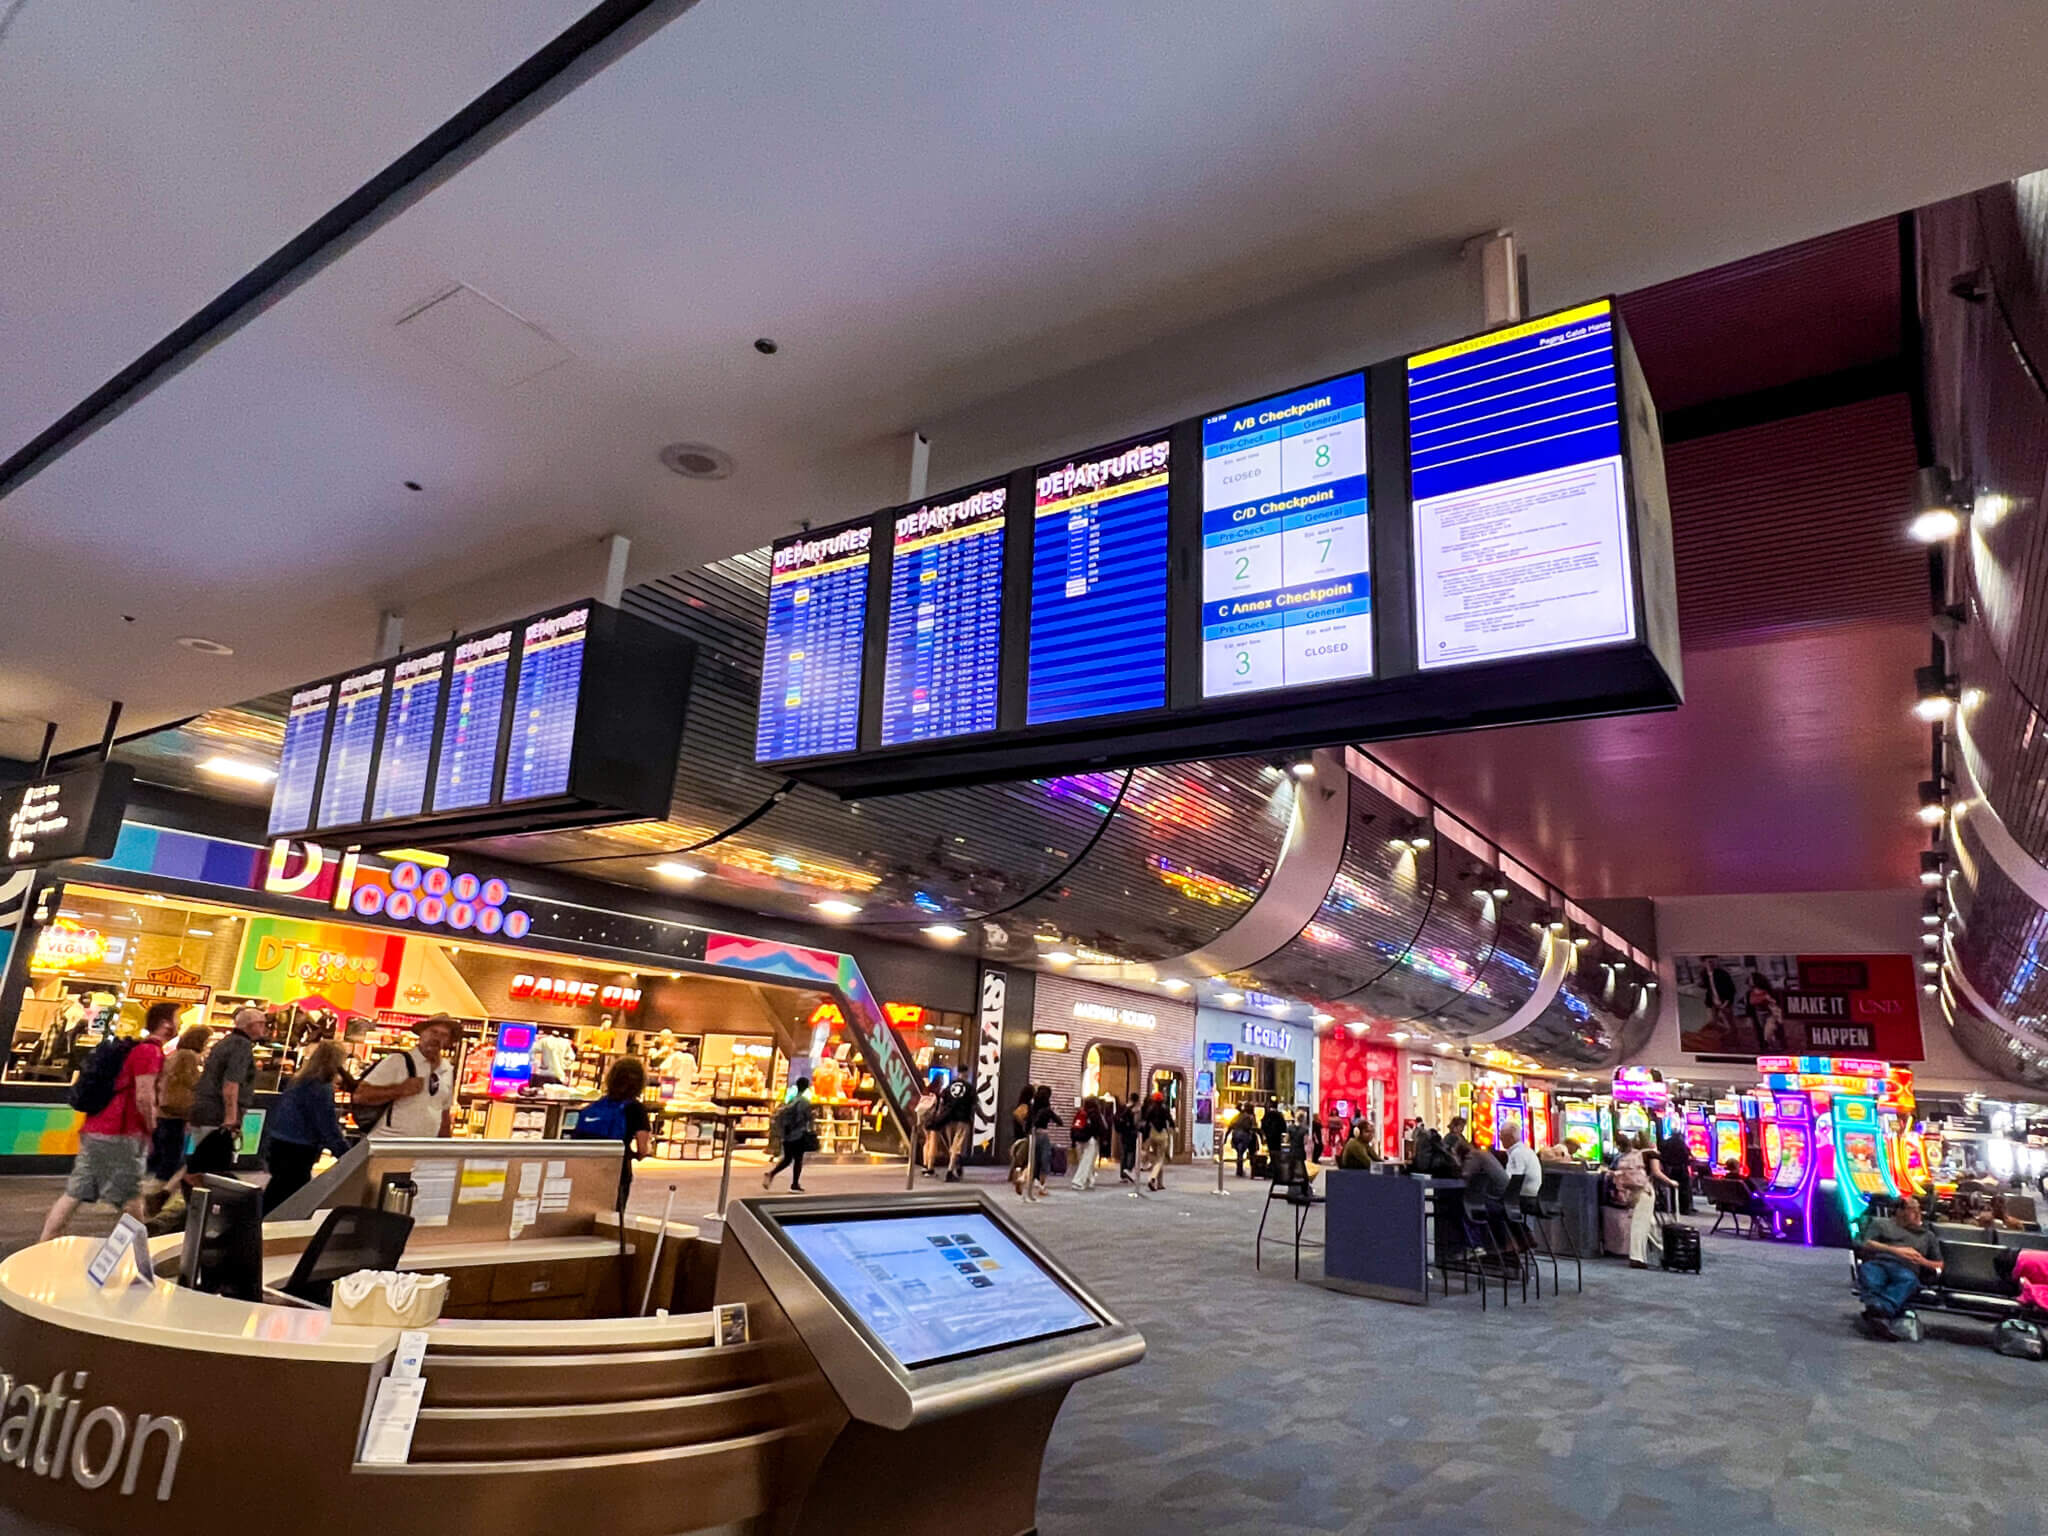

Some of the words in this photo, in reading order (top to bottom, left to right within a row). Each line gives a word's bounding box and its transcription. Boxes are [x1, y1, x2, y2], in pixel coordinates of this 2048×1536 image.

[1233, 417, 1256, 432] A/B
[1259, 396, 1332, 425] Checkpoint
[1303, 413, 1341, 430] General
[1219, 435, 1264, 453] Pre-Check
[1315, 444, 1331, 468] 8
[1039, 442, 1168, 497] DEPARTURES
[1223, 468, 1262, 485] CLOSED
[897, 489, 1005, 537] DEPARTURES
[1232, 507, 1257, 522] C/D
[1260, 489, 1335, 515] Checkpoint
[1304, 507, 1343, 523] General
[1219, 525, 1265, 542] Pre-Check
[775, 528, 870, 568] DEPARTURES
[1316, 538, 1332, 563] 7
[1235, 557, 1249, 581] 2
[1218, 605, 1228, 617] C
[1232, 598, 1272, 615] Annex
[1276, 582, 1353, 606] Checkpoint
[1306, 605, 1345, 619] General
[1219, 620, 1265, 634] Pre-Check
[1304, 642, 1349, 657] CLOSED
[1235, 651, 1251, 675] 3
[397, 864, 505, 903] ARTS
[134, 982, 206, 1001] HARLEY-DAVIDSON
[600, 985, 642, 1011] ON
[1787, 996, 1826, 1015] MAKE
[1830, 996, 1844, 1015] IT
[1811, 1027, 1869, 1047] HAPPEN
